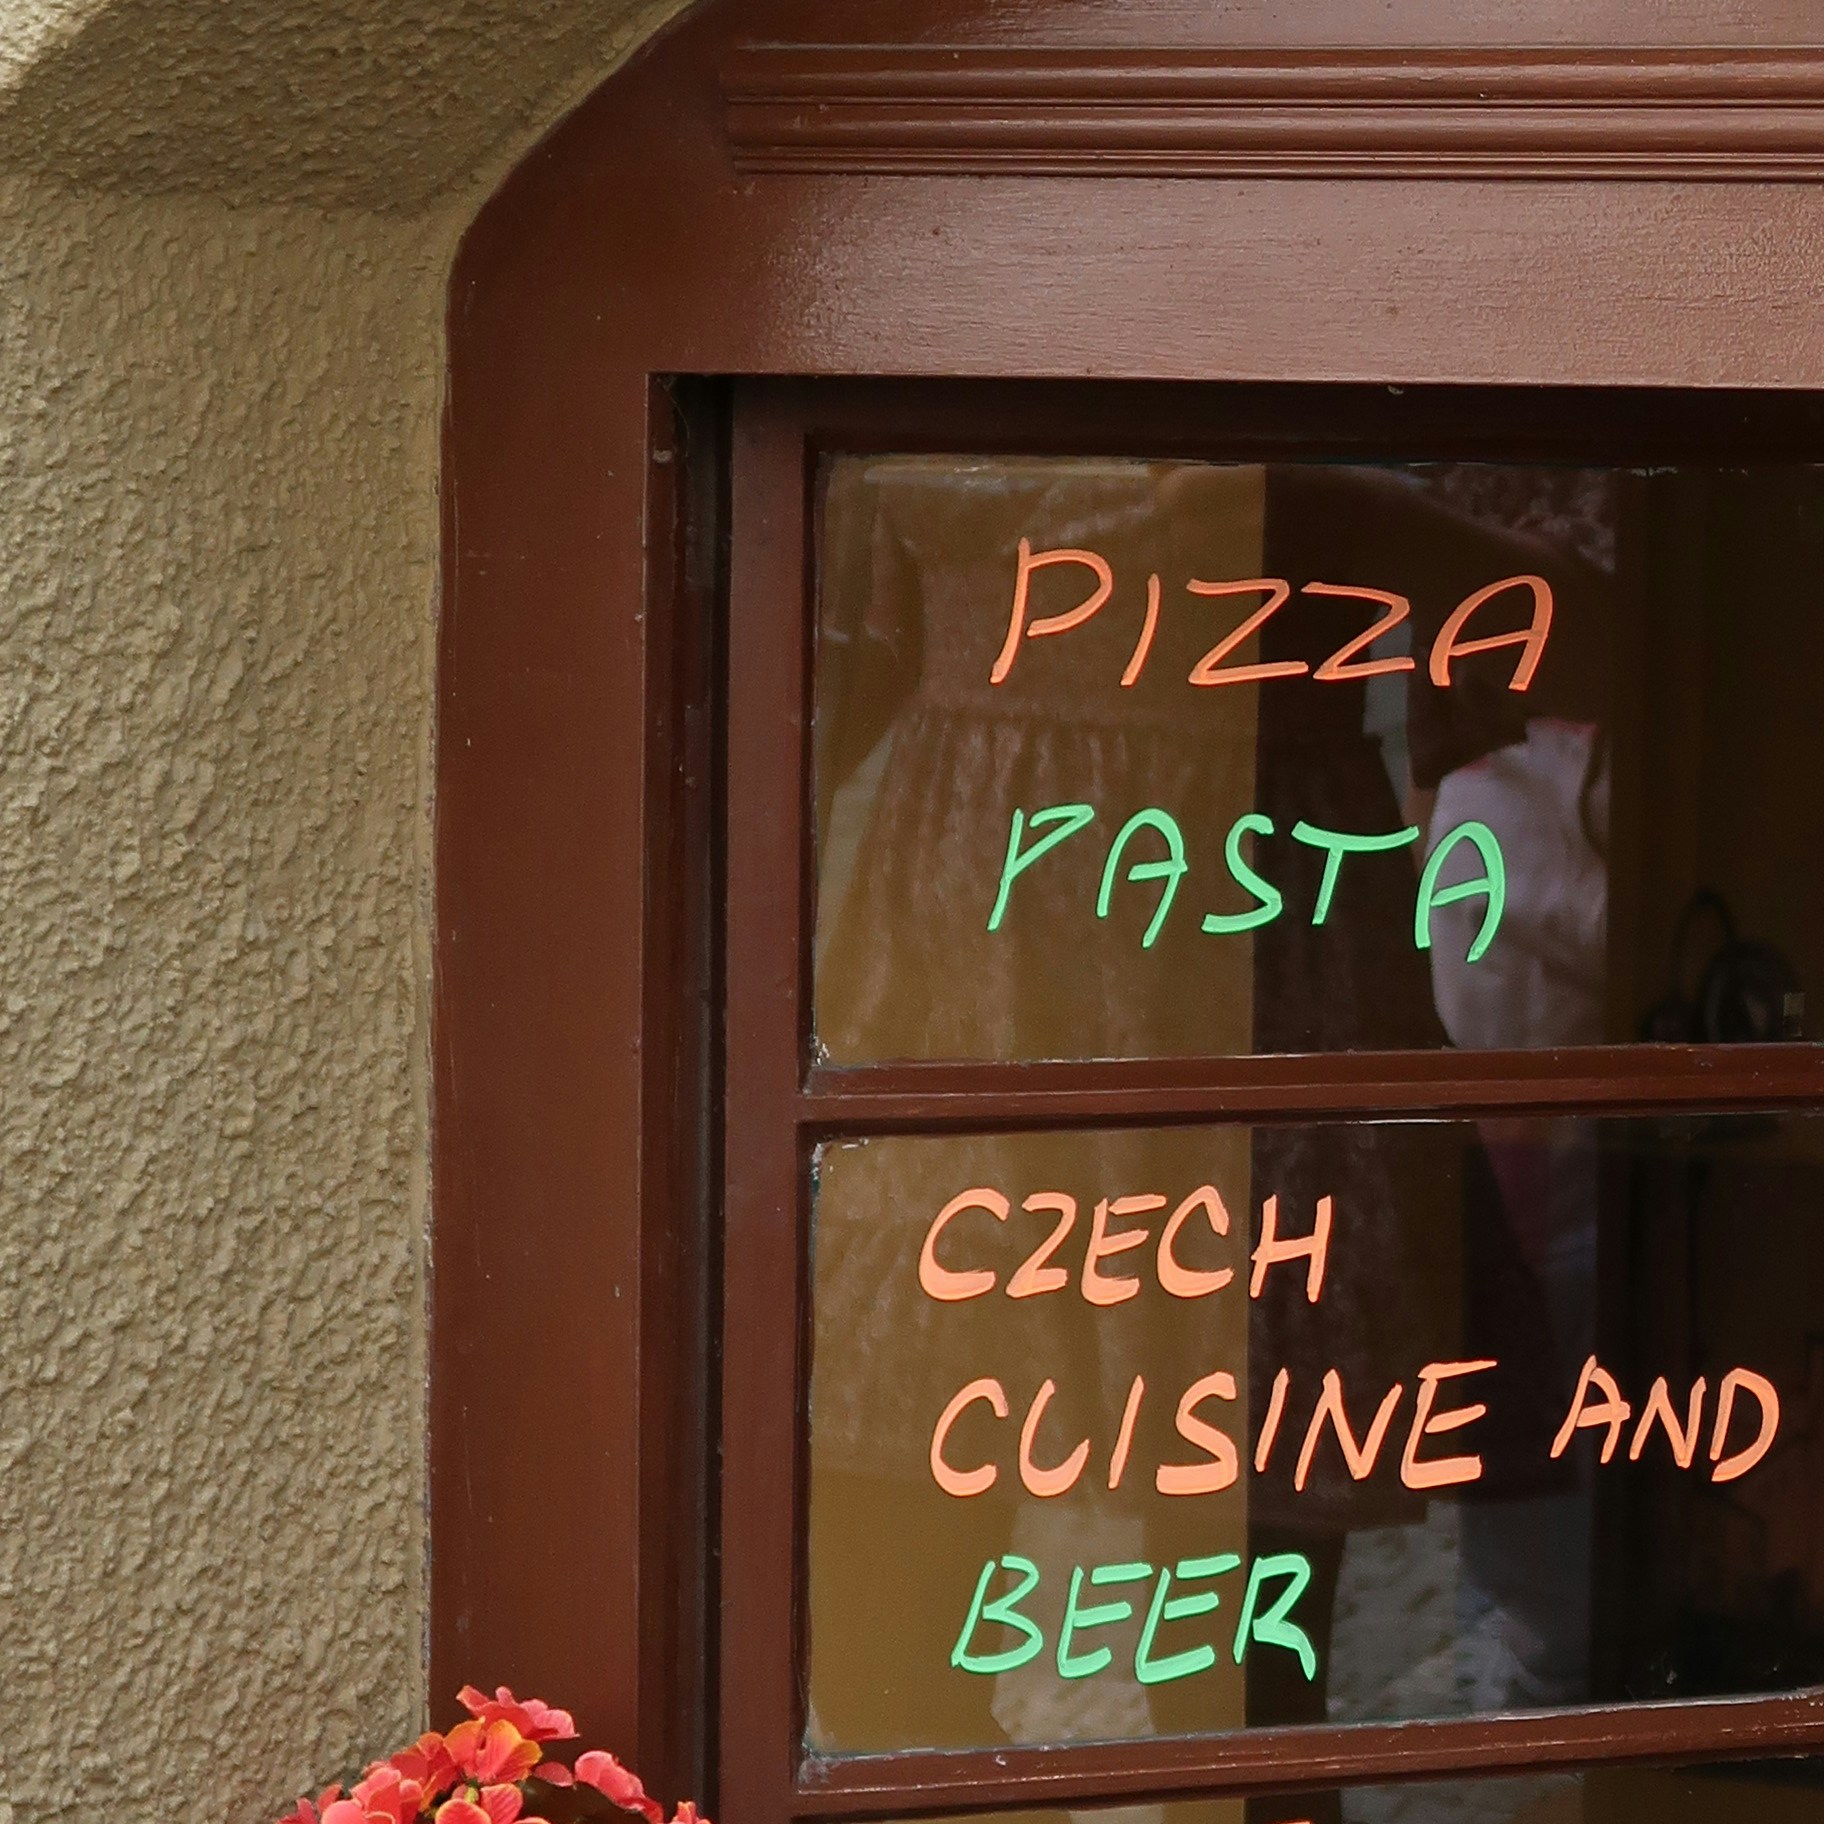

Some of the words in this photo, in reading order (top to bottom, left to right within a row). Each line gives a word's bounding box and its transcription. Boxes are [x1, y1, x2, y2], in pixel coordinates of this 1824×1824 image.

[990, 538, 1553, 691] PIZZA
[988, 804, 1506, 963] PASTA
[918, 1184, 1332, 1306] CZECH
[930, 1359, 1498, 1497] CUISINE
[1550, 1354, 1780, 1482] AND
[951, 1553, 1316, 1684] BEER
